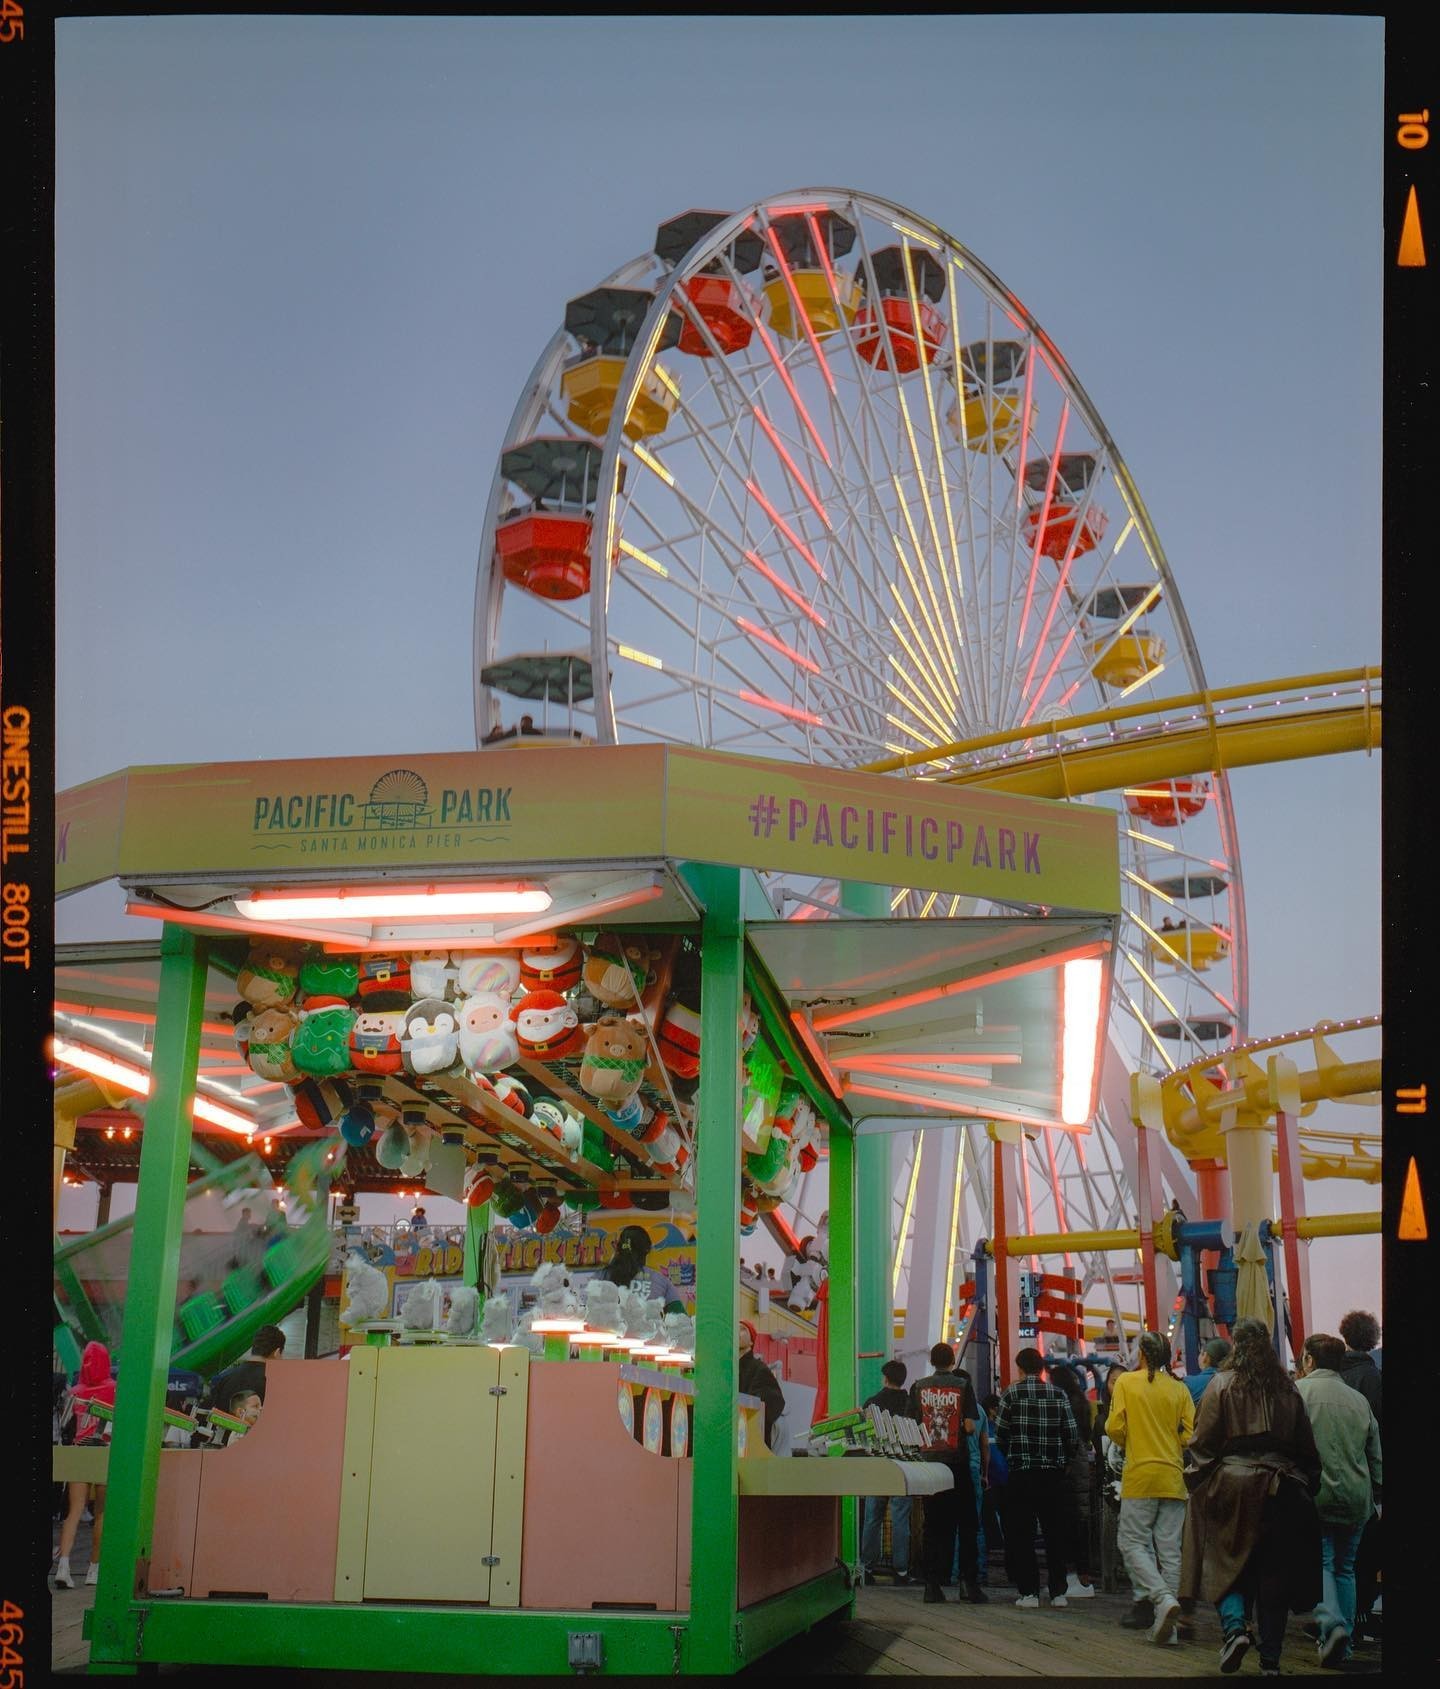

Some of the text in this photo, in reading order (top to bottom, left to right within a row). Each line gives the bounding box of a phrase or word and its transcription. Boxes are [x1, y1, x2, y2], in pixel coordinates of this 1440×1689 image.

[253, 787, 513, 831] PACIFIC PARK
[300, 833, 462, 853] SANTA MONICA PIER
[747, 793, 1042, 876] #PACIFICPARK
[415, 1234, 616, 1275] RID TICKETS
[167, 1380, 188, 1392] els
